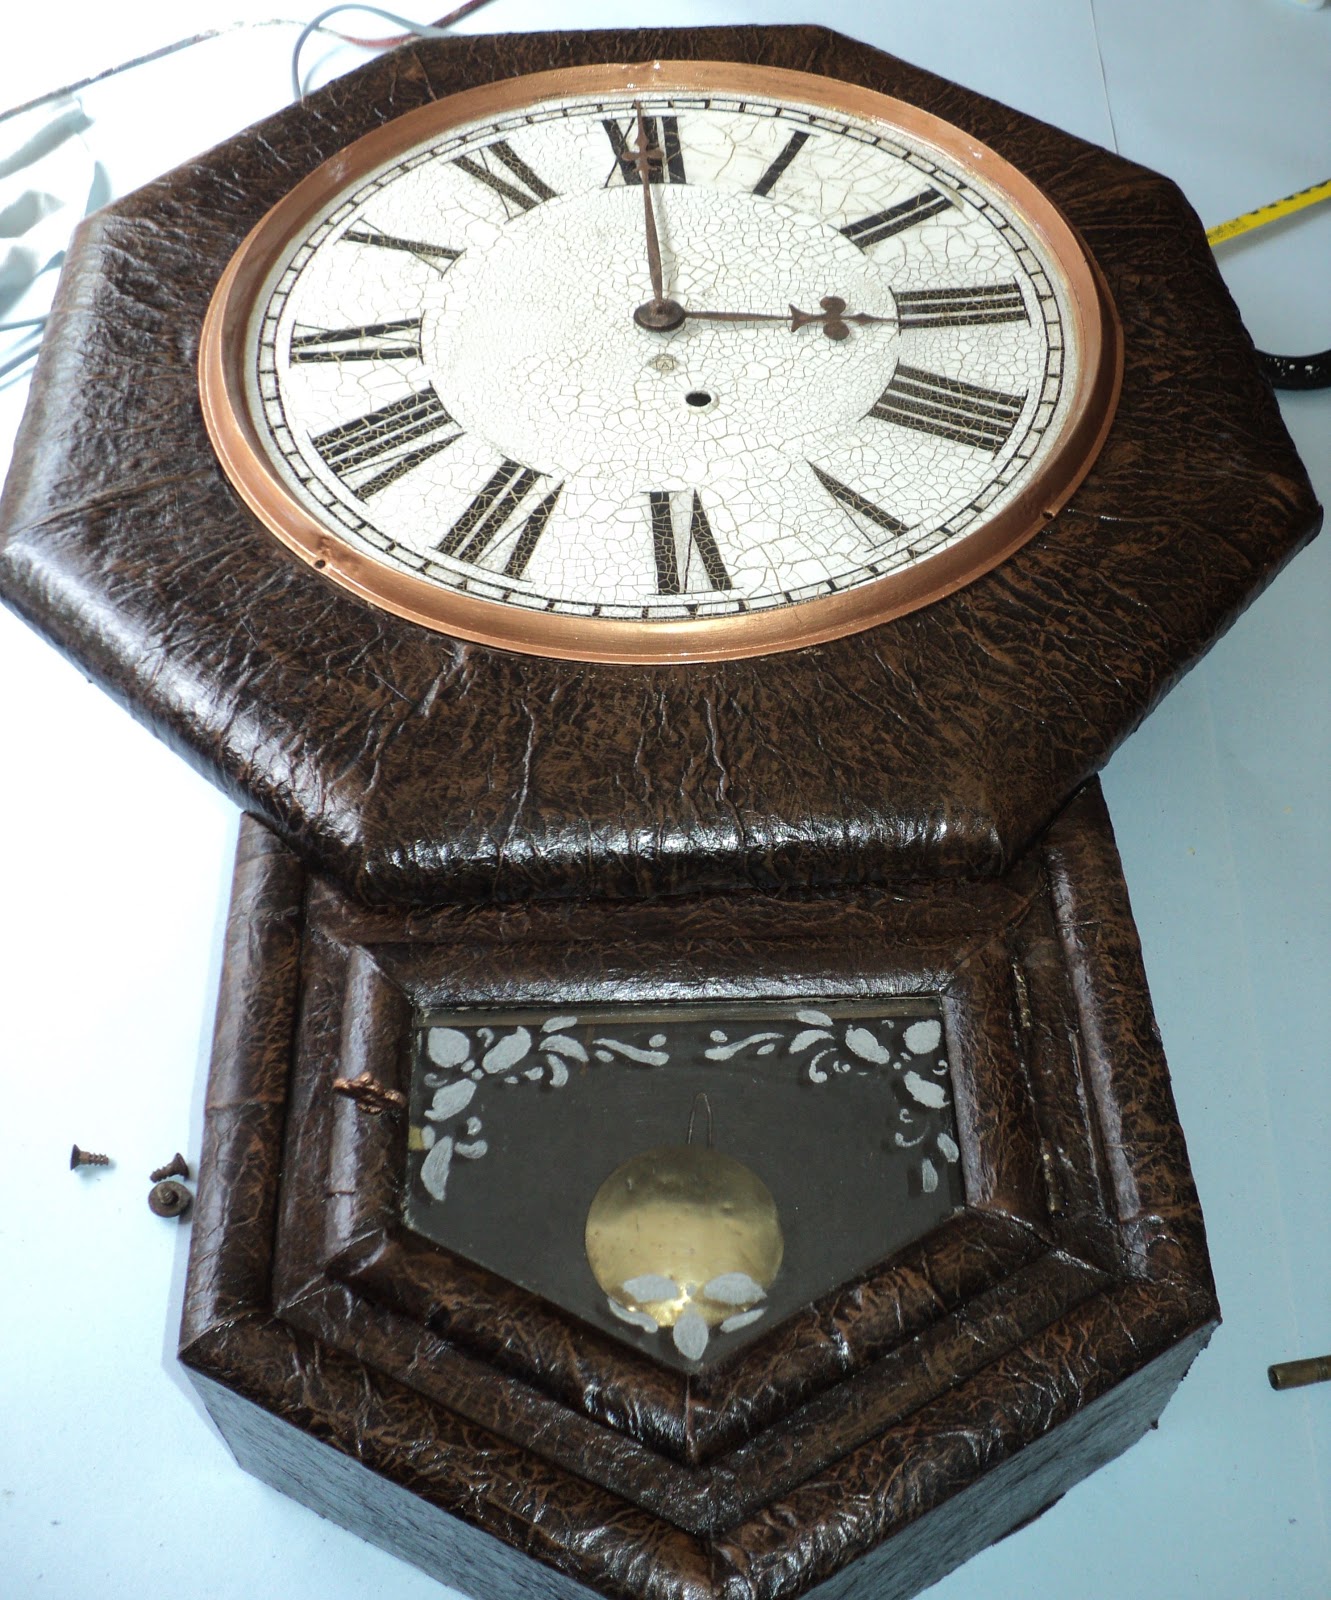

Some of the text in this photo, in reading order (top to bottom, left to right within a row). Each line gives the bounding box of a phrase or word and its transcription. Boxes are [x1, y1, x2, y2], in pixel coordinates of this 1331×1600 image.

[443, 139, 564, 224] XI
[598, 115, 694, 189] XII
[749, 127, 820, 199] I
[334, 216, 467, 279] X
[828, 184, 955, 255] II
[289, 309, 426, 368] IX
[888, 276, 1031, 336] III
[307, 380, 467, 505] VIII
[858, 358, 1029, 460] IIII
[430, 454, 565, 582] VII
[641, 488, 743, 596] VI
[805, 458, 920, 552] V
